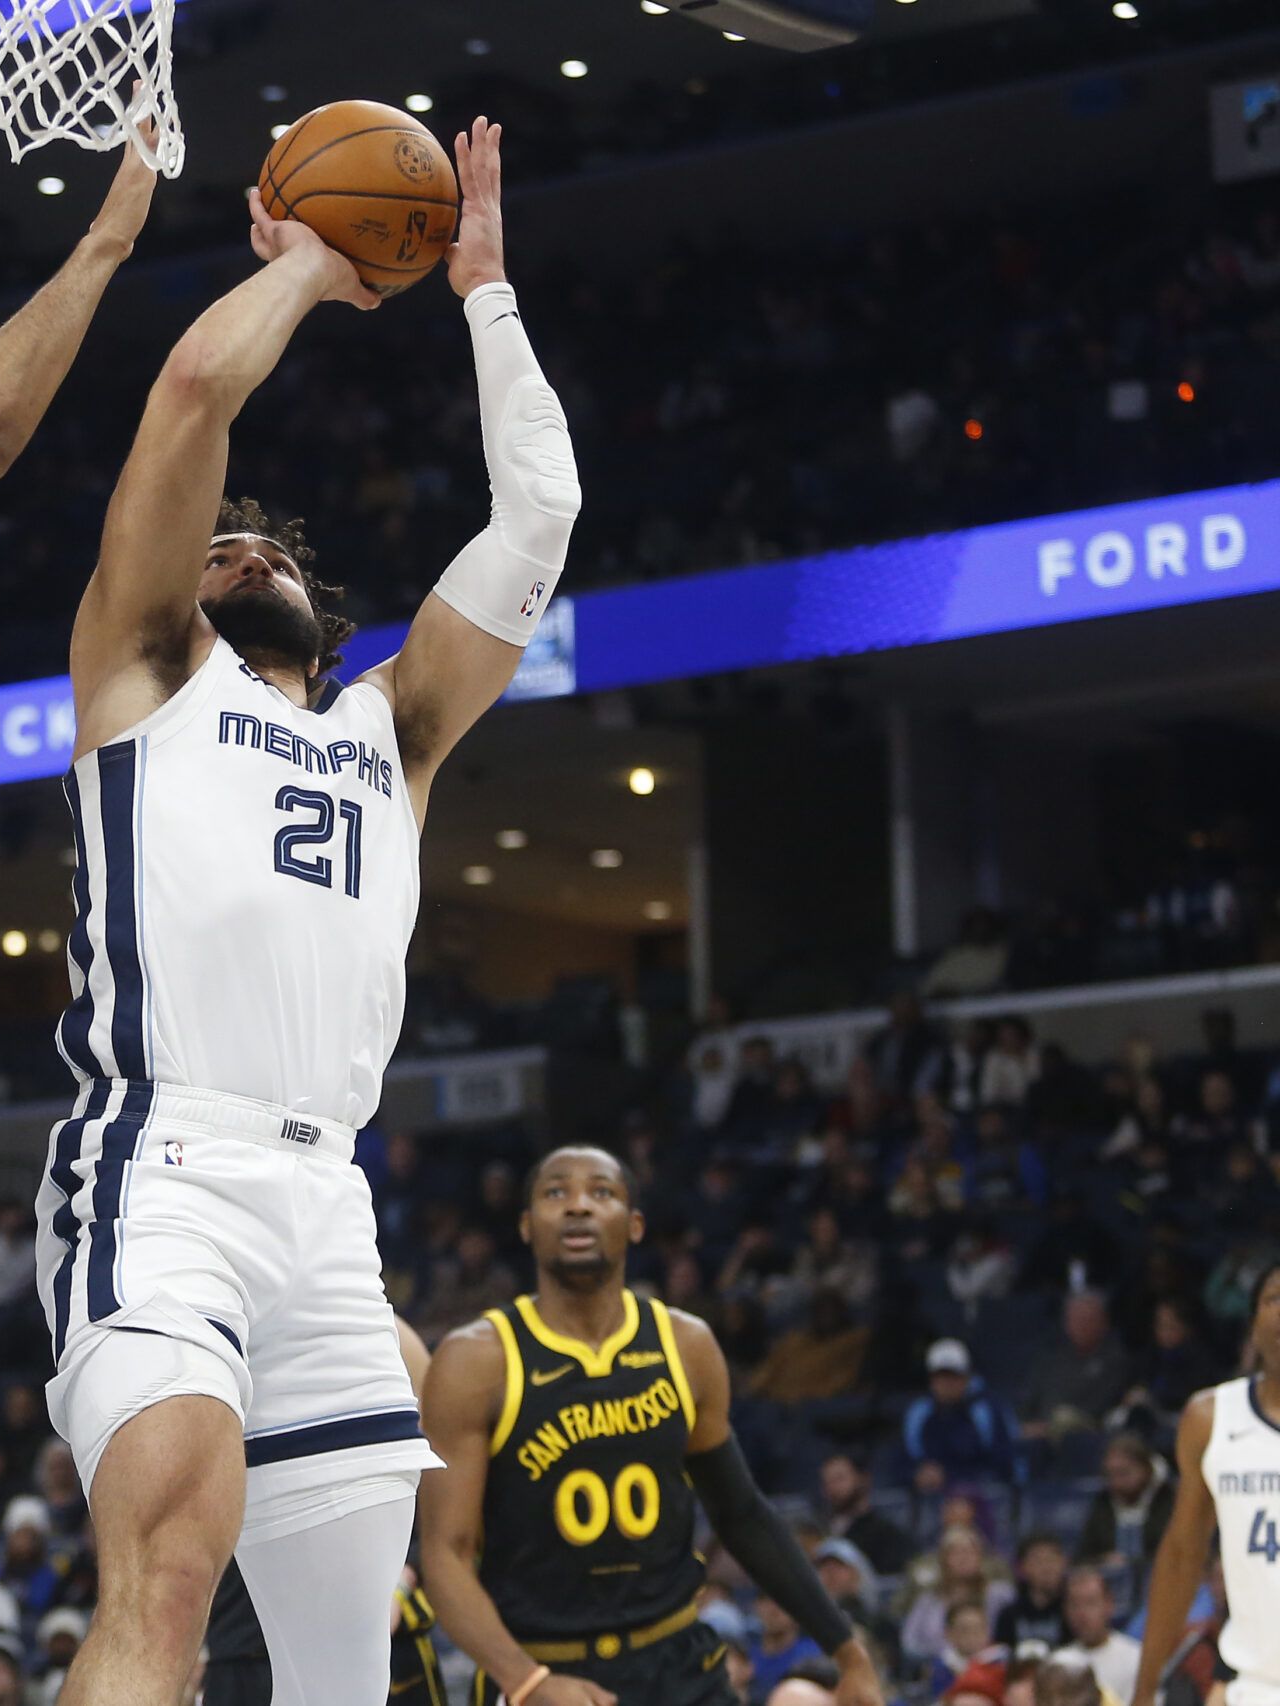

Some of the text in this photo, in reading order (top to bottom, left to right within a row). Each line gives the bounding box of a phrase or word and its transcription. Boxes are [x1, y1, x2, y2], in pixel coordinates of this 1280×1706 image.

[1037, 512, 1247, 597] FORD
[218, 711, 393, 800] MEMPHIS
[273, 784, 362, 900] 21
[518, 1377, 679, 1482] SAN FRANCISCO
[554, 1462, 660, 1547] 00
